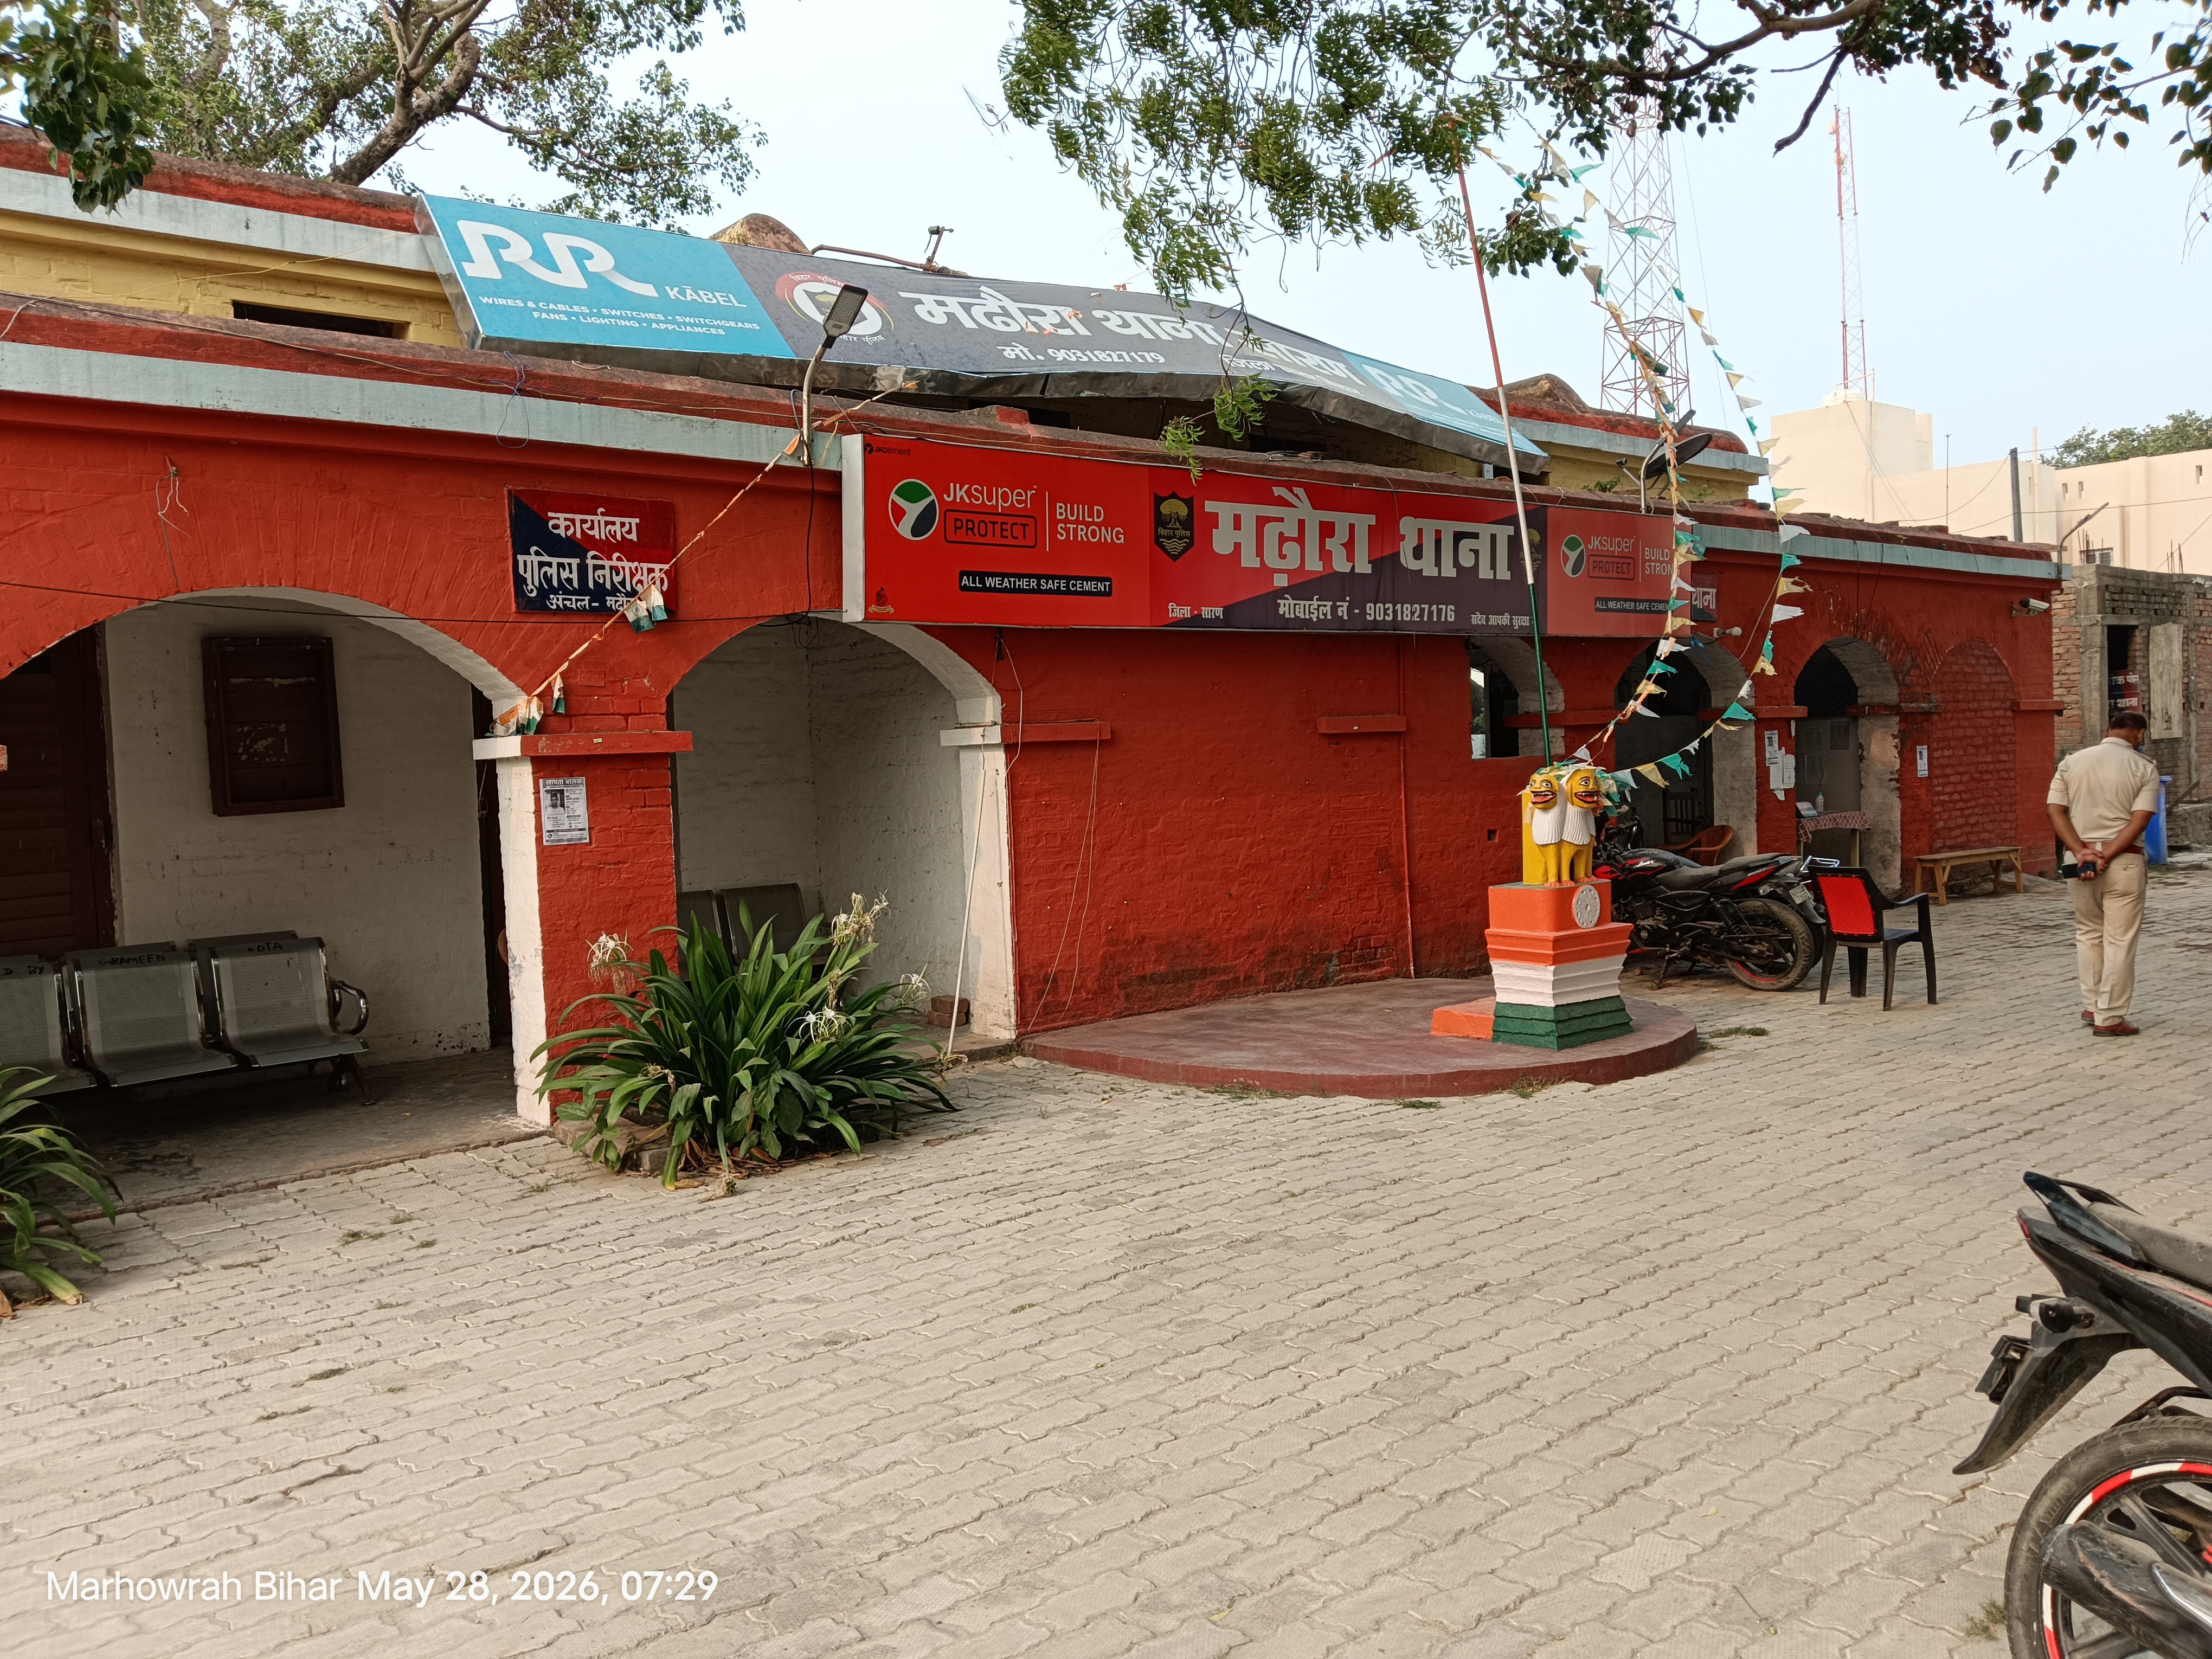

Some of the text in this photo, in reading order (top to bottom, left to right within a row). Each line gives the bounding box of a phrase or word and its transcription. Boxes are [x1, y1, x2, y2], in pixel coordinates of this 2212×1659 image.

[478, 295, 525, 308] WIRES
[538, 302, 589, 313] CABLES
[600, 307, 665, 321] SWITCHES
[675, 315, 760, 330] SWITCHGEARS
[532, 311, 725, 336] FANS LIGHTING APPLIANCES
[1047, 348, 1165, 364] 9031827179
[1056, 502, 1104, 523] BUILD
[548, 507, 640, 543] कार्यालय
[954, 517, 1030, 541] PROTECT
[1057, 523, 1125, 544] STRONG
[1205, 486, 1514, 587] मढ़ौरा थाना
[1645, 547, 1670, 561] BUILD
[517, 546, 670, 597] पुलिस निरीक्षक
[1592, 560, 1631, 575] PROTECT
[1645, 562, 1680, 576] STRON
[961, 575, 1111, 593] ALL WEATHER SAFE CEMENT
[546, 590, 590, 610] अंचल
[1277, 594, 1333, 621] मोबाईल
[1337, 596, 1350, 620] नं
[1366, 602, 1455, 622] 9031827176
[1596, 600, 1669, 611] ALL WEATHER SAFE CEMEN
[1168, 602, 1191, 619] जिला
[1201, 606, 1224, 620] सारण
[1470, 611, 1487, 625] सदैव
[1488, 613, 1510, 626] आपकी
[1512, 615, 1530, 629] सुरक्षा
[98, 953, 166, 966] GRAMEEN
[27, 965, 44, 975] BY
